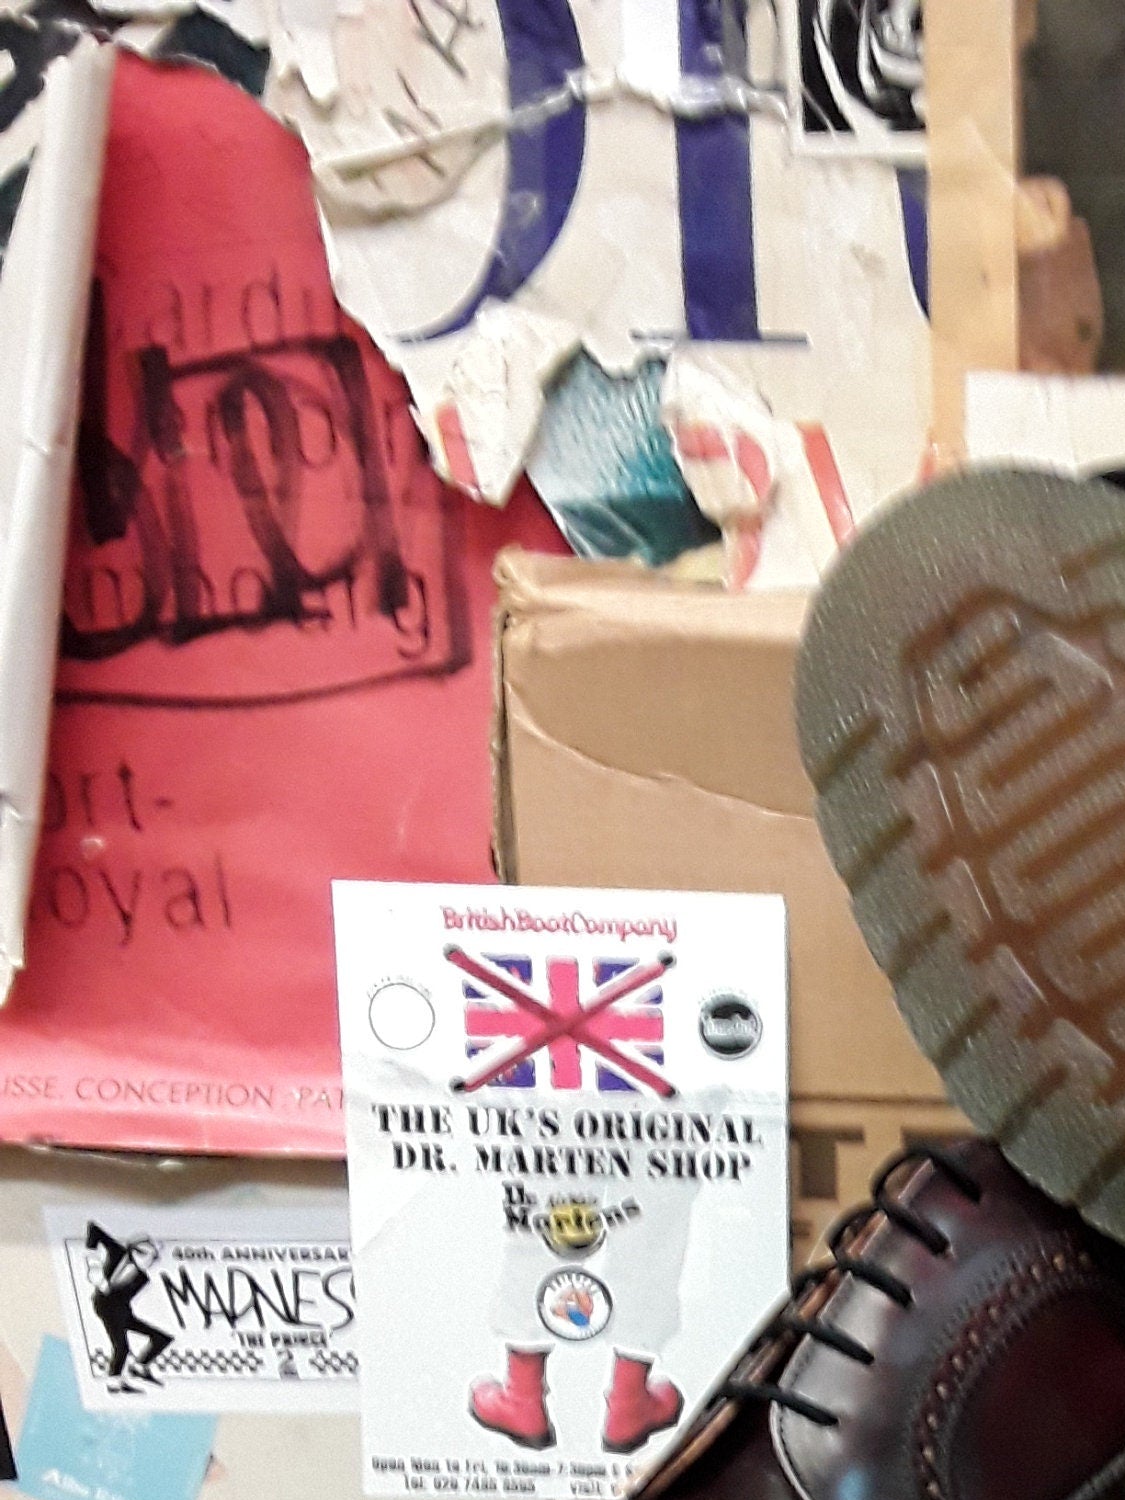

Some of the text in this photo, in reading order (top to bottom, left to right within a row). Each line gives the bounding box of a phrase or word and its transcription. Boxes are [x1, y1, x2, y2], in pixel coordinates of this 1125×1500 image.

[48, 852, 233, 948] oyal
[74, 1076, 275, 1110] CONCEPTION
[372, 1102, 764, 1146] THE UK'S ORIGINAL
[392, 1142, 457, 1173] DR.
[475, 1145, 632, 1178] MARTEN
[647, 1150, 752, 1182] SHOP
[222, 1246, 350, 1263] ANNIVERSAR
[160, 1265, 356, 1330] MADNES
